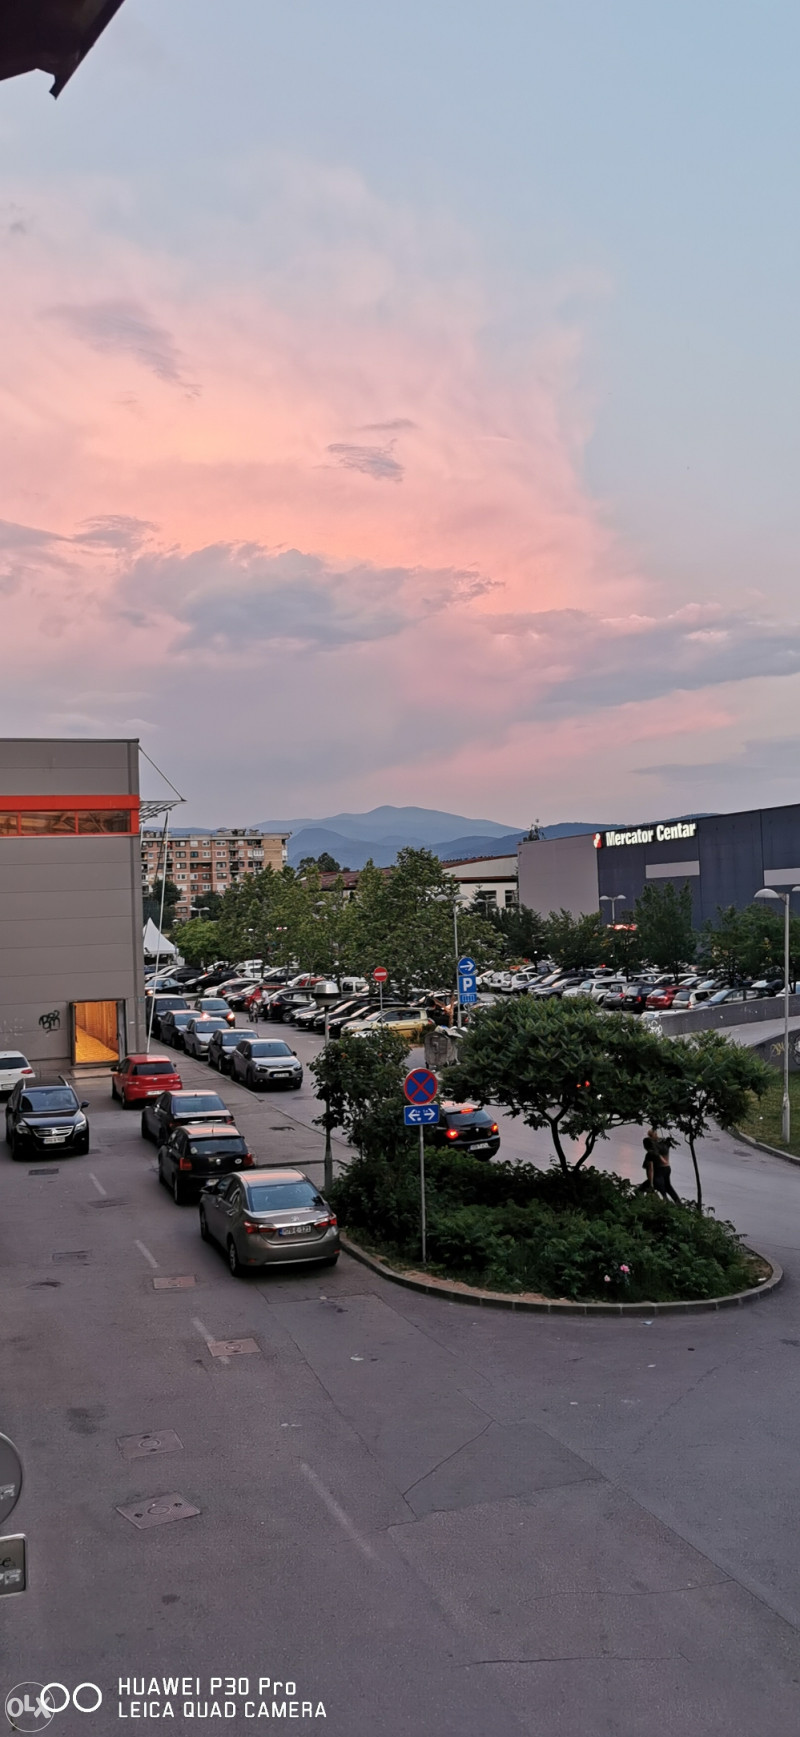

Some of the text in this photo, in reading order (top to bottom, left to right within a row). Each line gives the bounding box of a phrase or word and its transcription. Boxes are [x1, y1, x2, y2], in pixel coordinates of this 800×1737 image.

[605, 822, 696, 847] Mercator Centar
[463, 977, 473, 992] P
